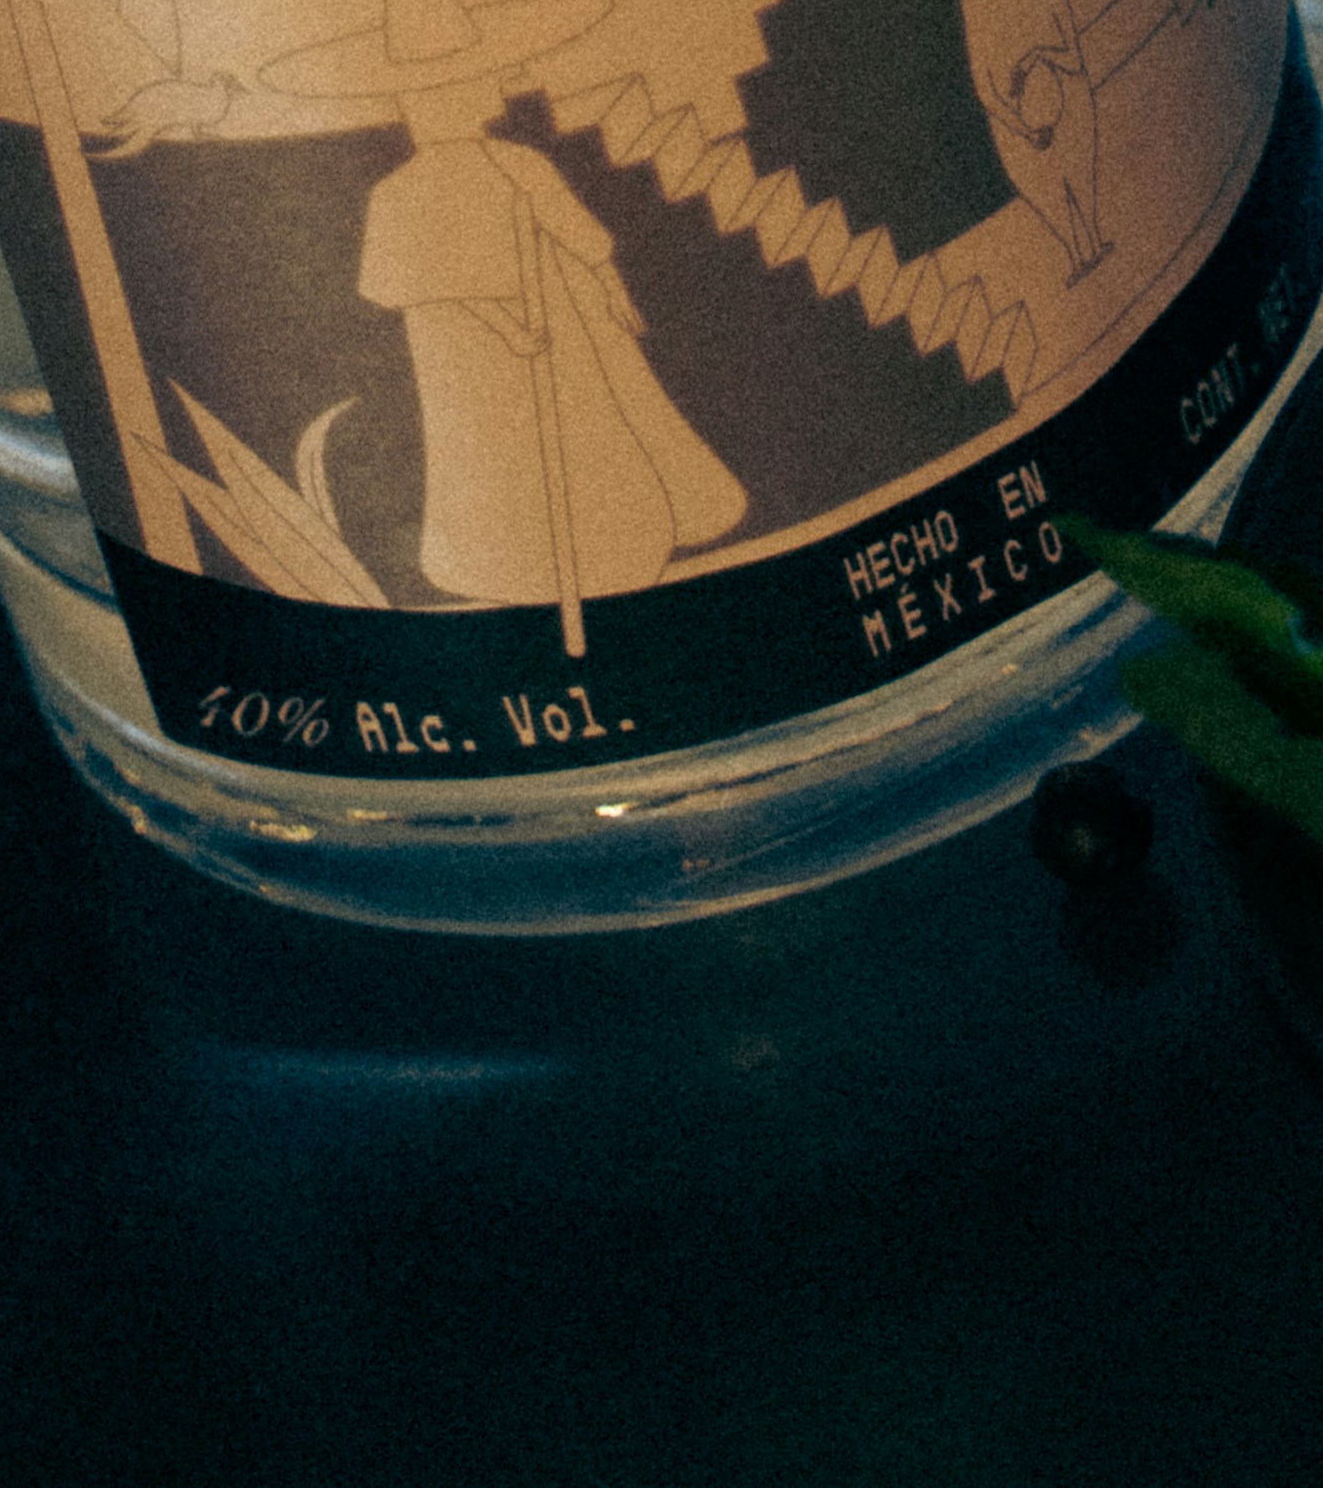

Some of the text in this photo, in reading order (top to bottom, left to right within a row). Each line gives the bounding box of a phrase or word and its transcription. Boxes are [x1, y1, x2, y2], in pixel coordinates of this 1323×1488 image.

[842, 459, 1048, 601] HECHO EN
[861, 520, 1064, 659] MÉXICO
[355, 700, 478, 754] Alc.
[501, 685, 635, 748] Vol.
